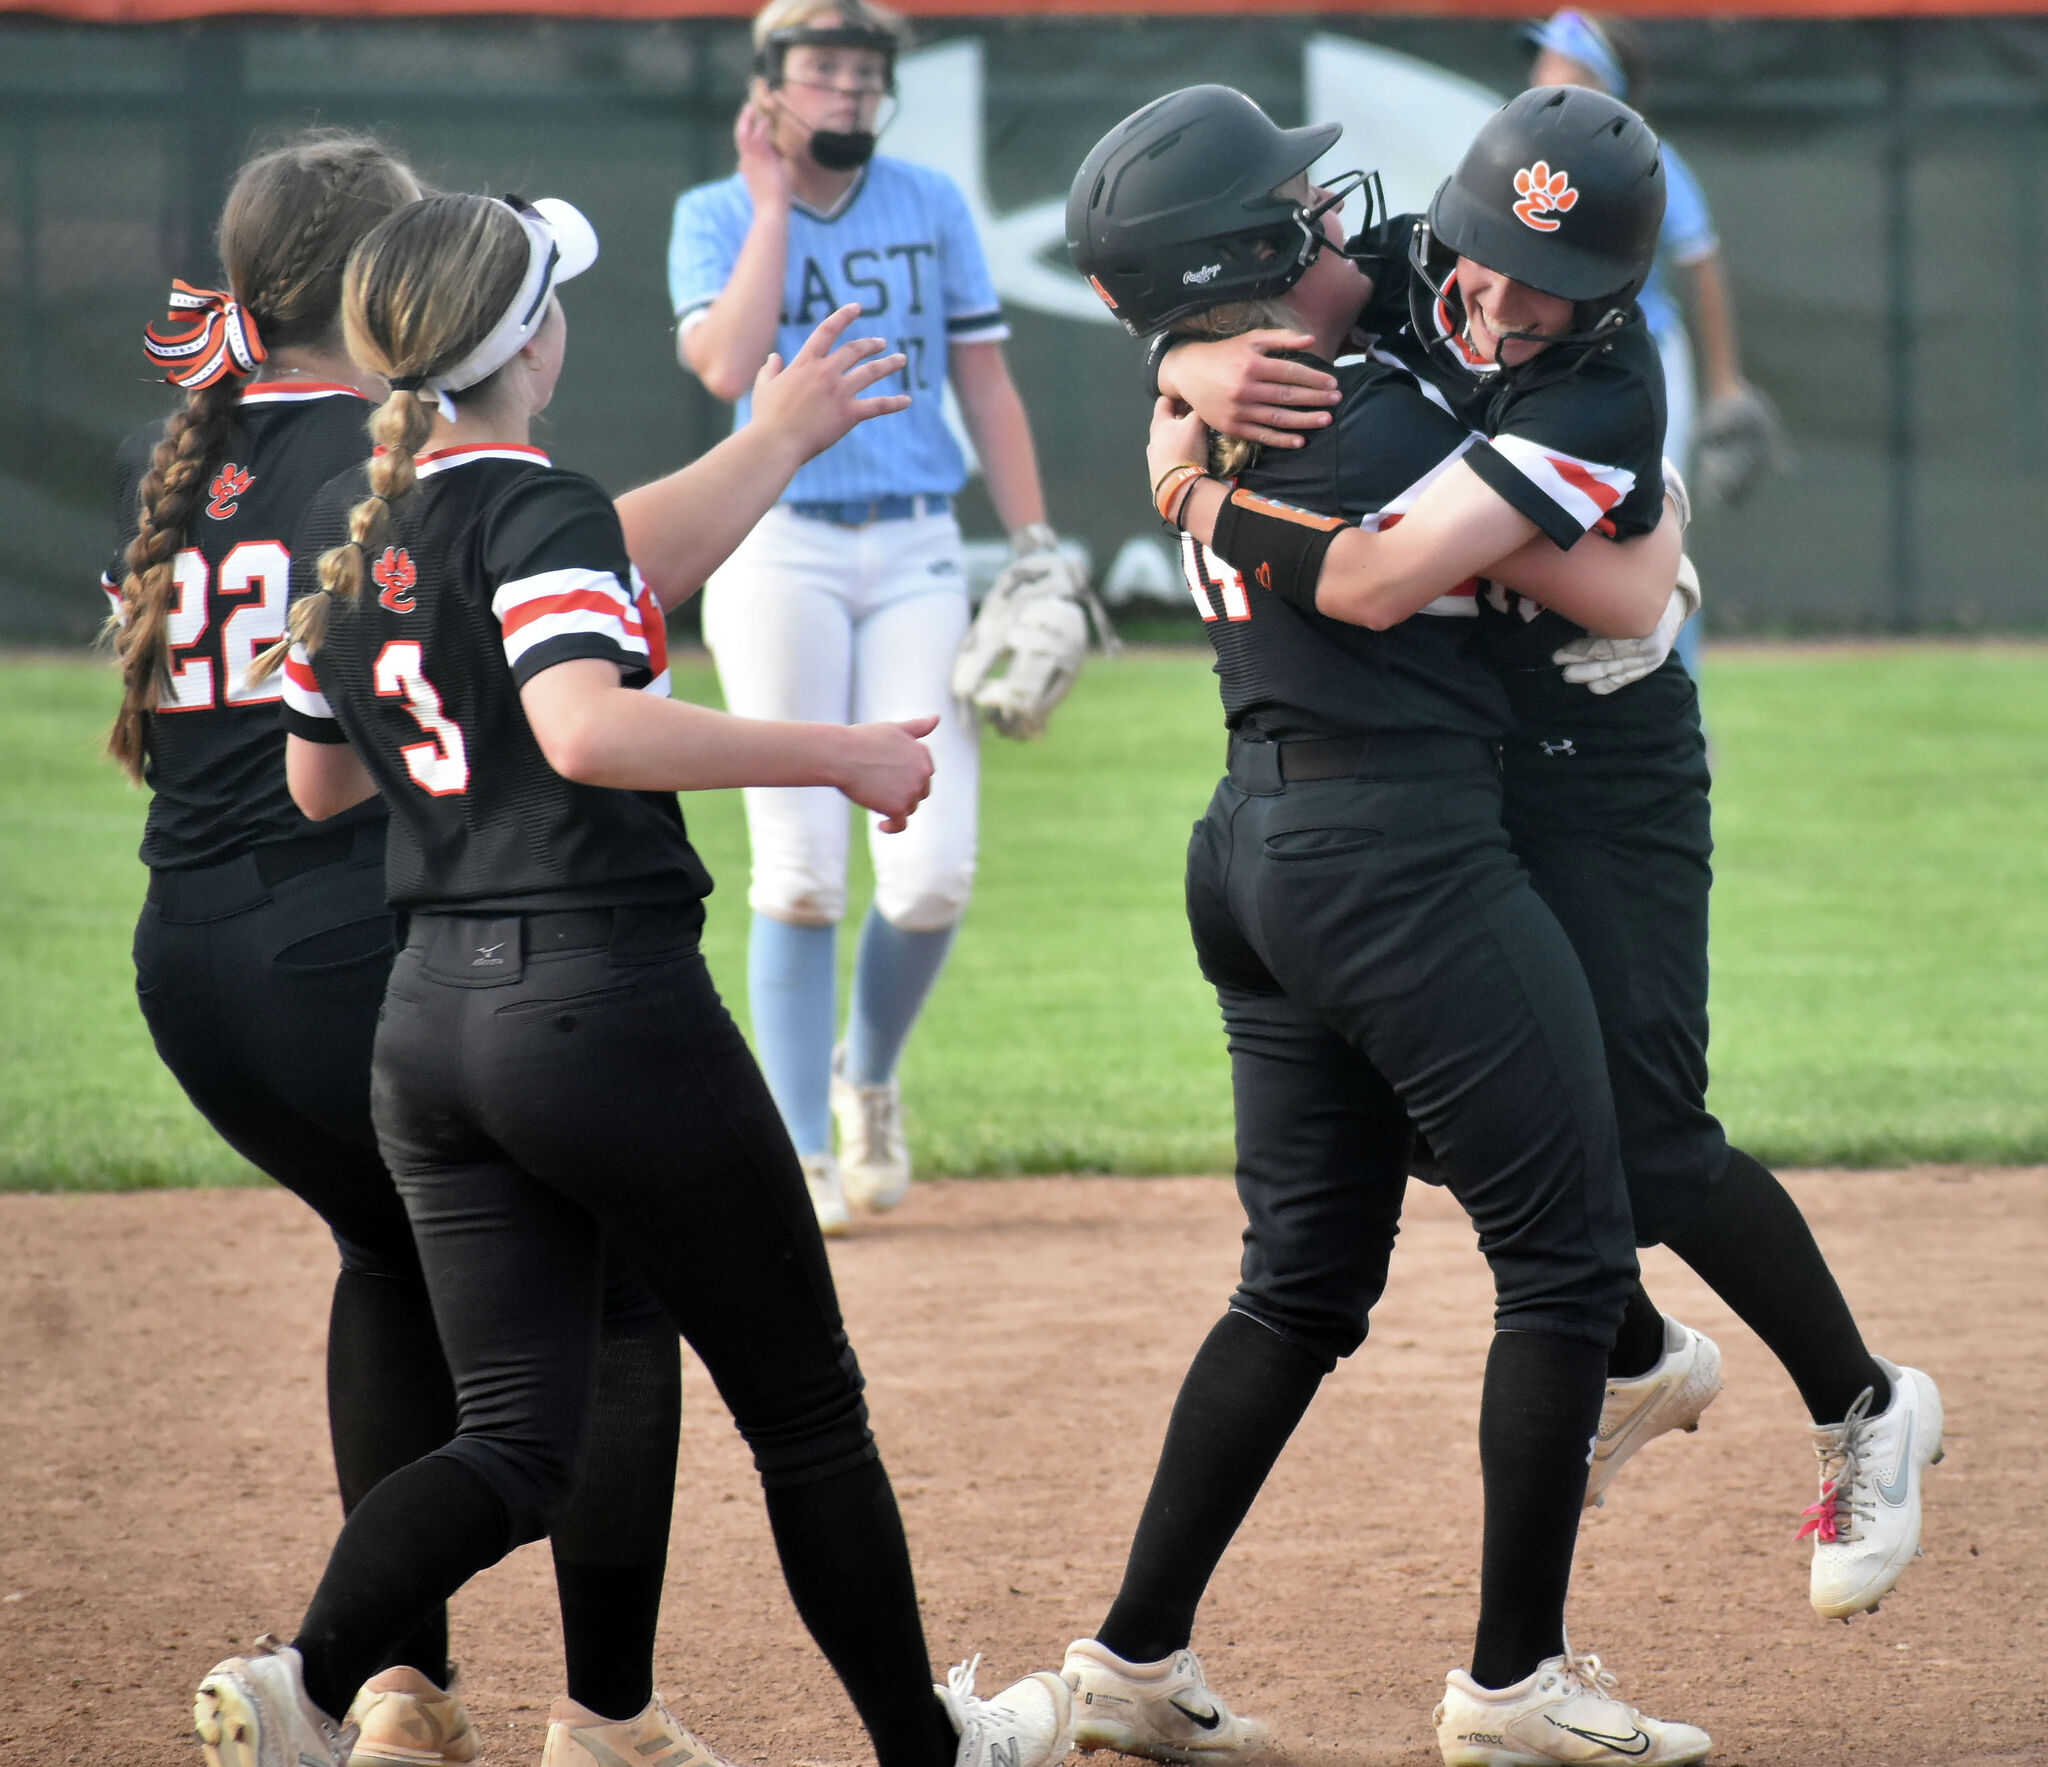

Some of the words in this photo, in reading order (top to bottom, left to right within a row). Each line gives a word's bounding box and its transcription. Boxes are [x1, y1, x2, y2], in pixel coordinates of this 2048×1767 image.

[779, 243, 935, 325] AST
[1182, 263, 1222, 285] Rawlings
[156, 539, 291, 713] 22
[373, 640, 470, 797] 3
